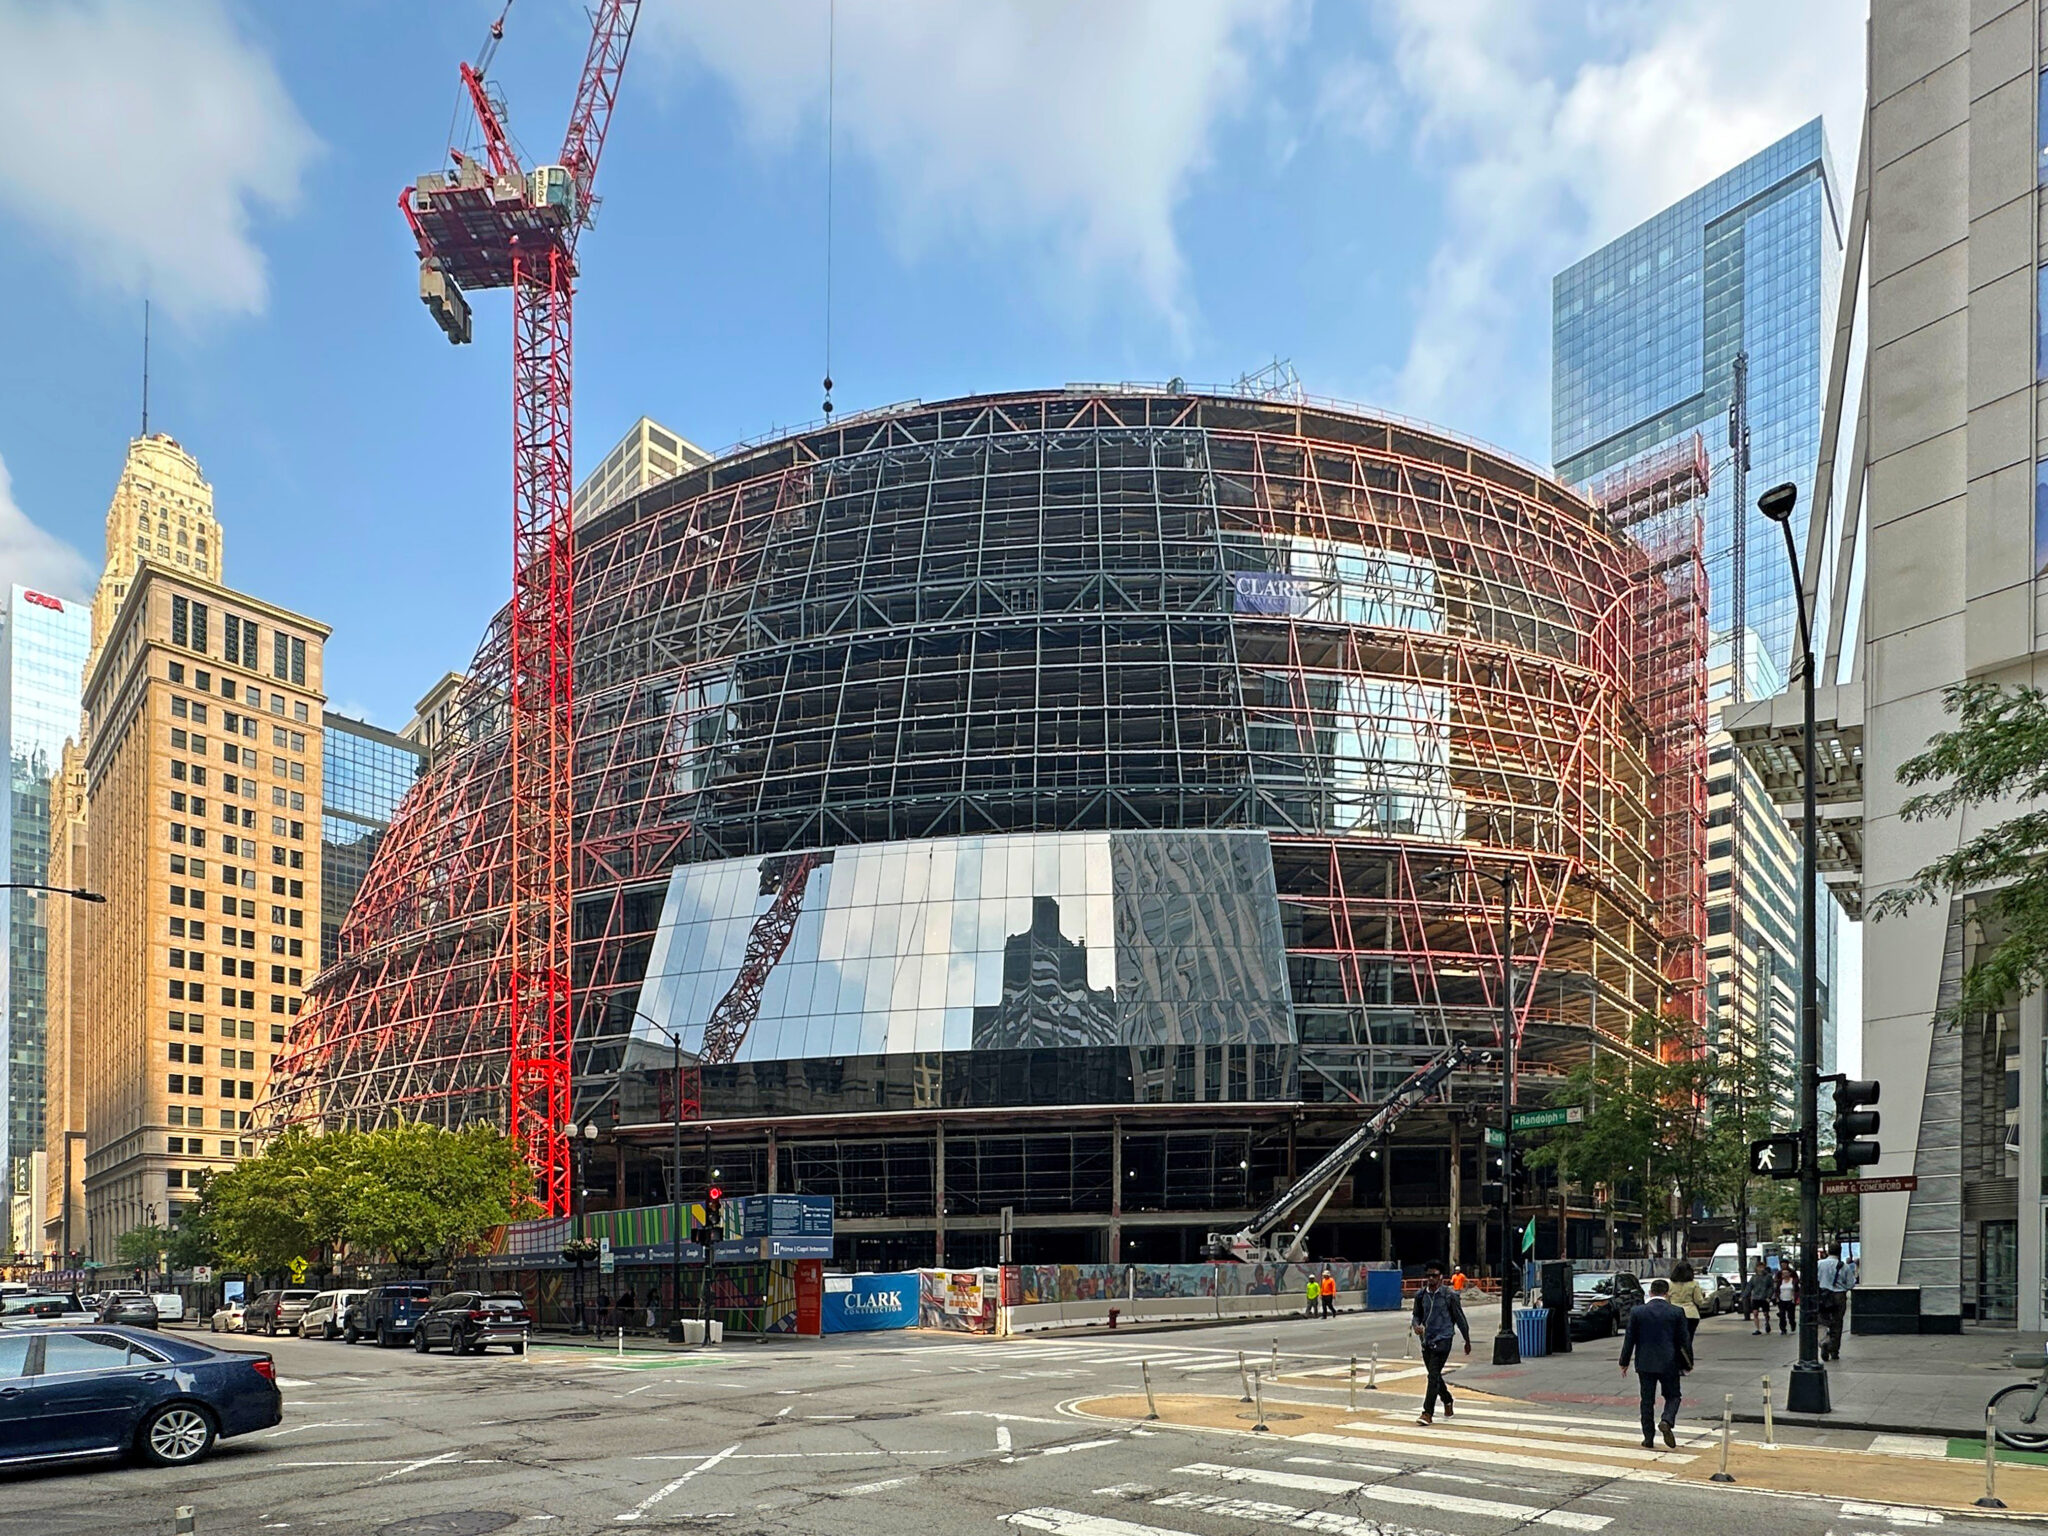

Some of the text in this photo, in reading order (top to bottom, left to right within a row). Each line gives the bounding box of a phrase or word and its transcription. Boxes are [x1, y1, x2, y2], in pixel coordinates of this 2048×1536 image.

[497, 178, 519, 196] ALL
[1236, 577, 1306, 598] CLARK
[1520, 1113, 1558, 1126] Randolph
[1826, 1185, 1848, 1194] HARRY
[1860, 1182, 1901, 1191] COMERFORD
[745, 1246, 758, 1254] Google
[844, 1291, 902, 1309] CLARK
[844, 1306, 903, 1315] CONSTRUCTION
